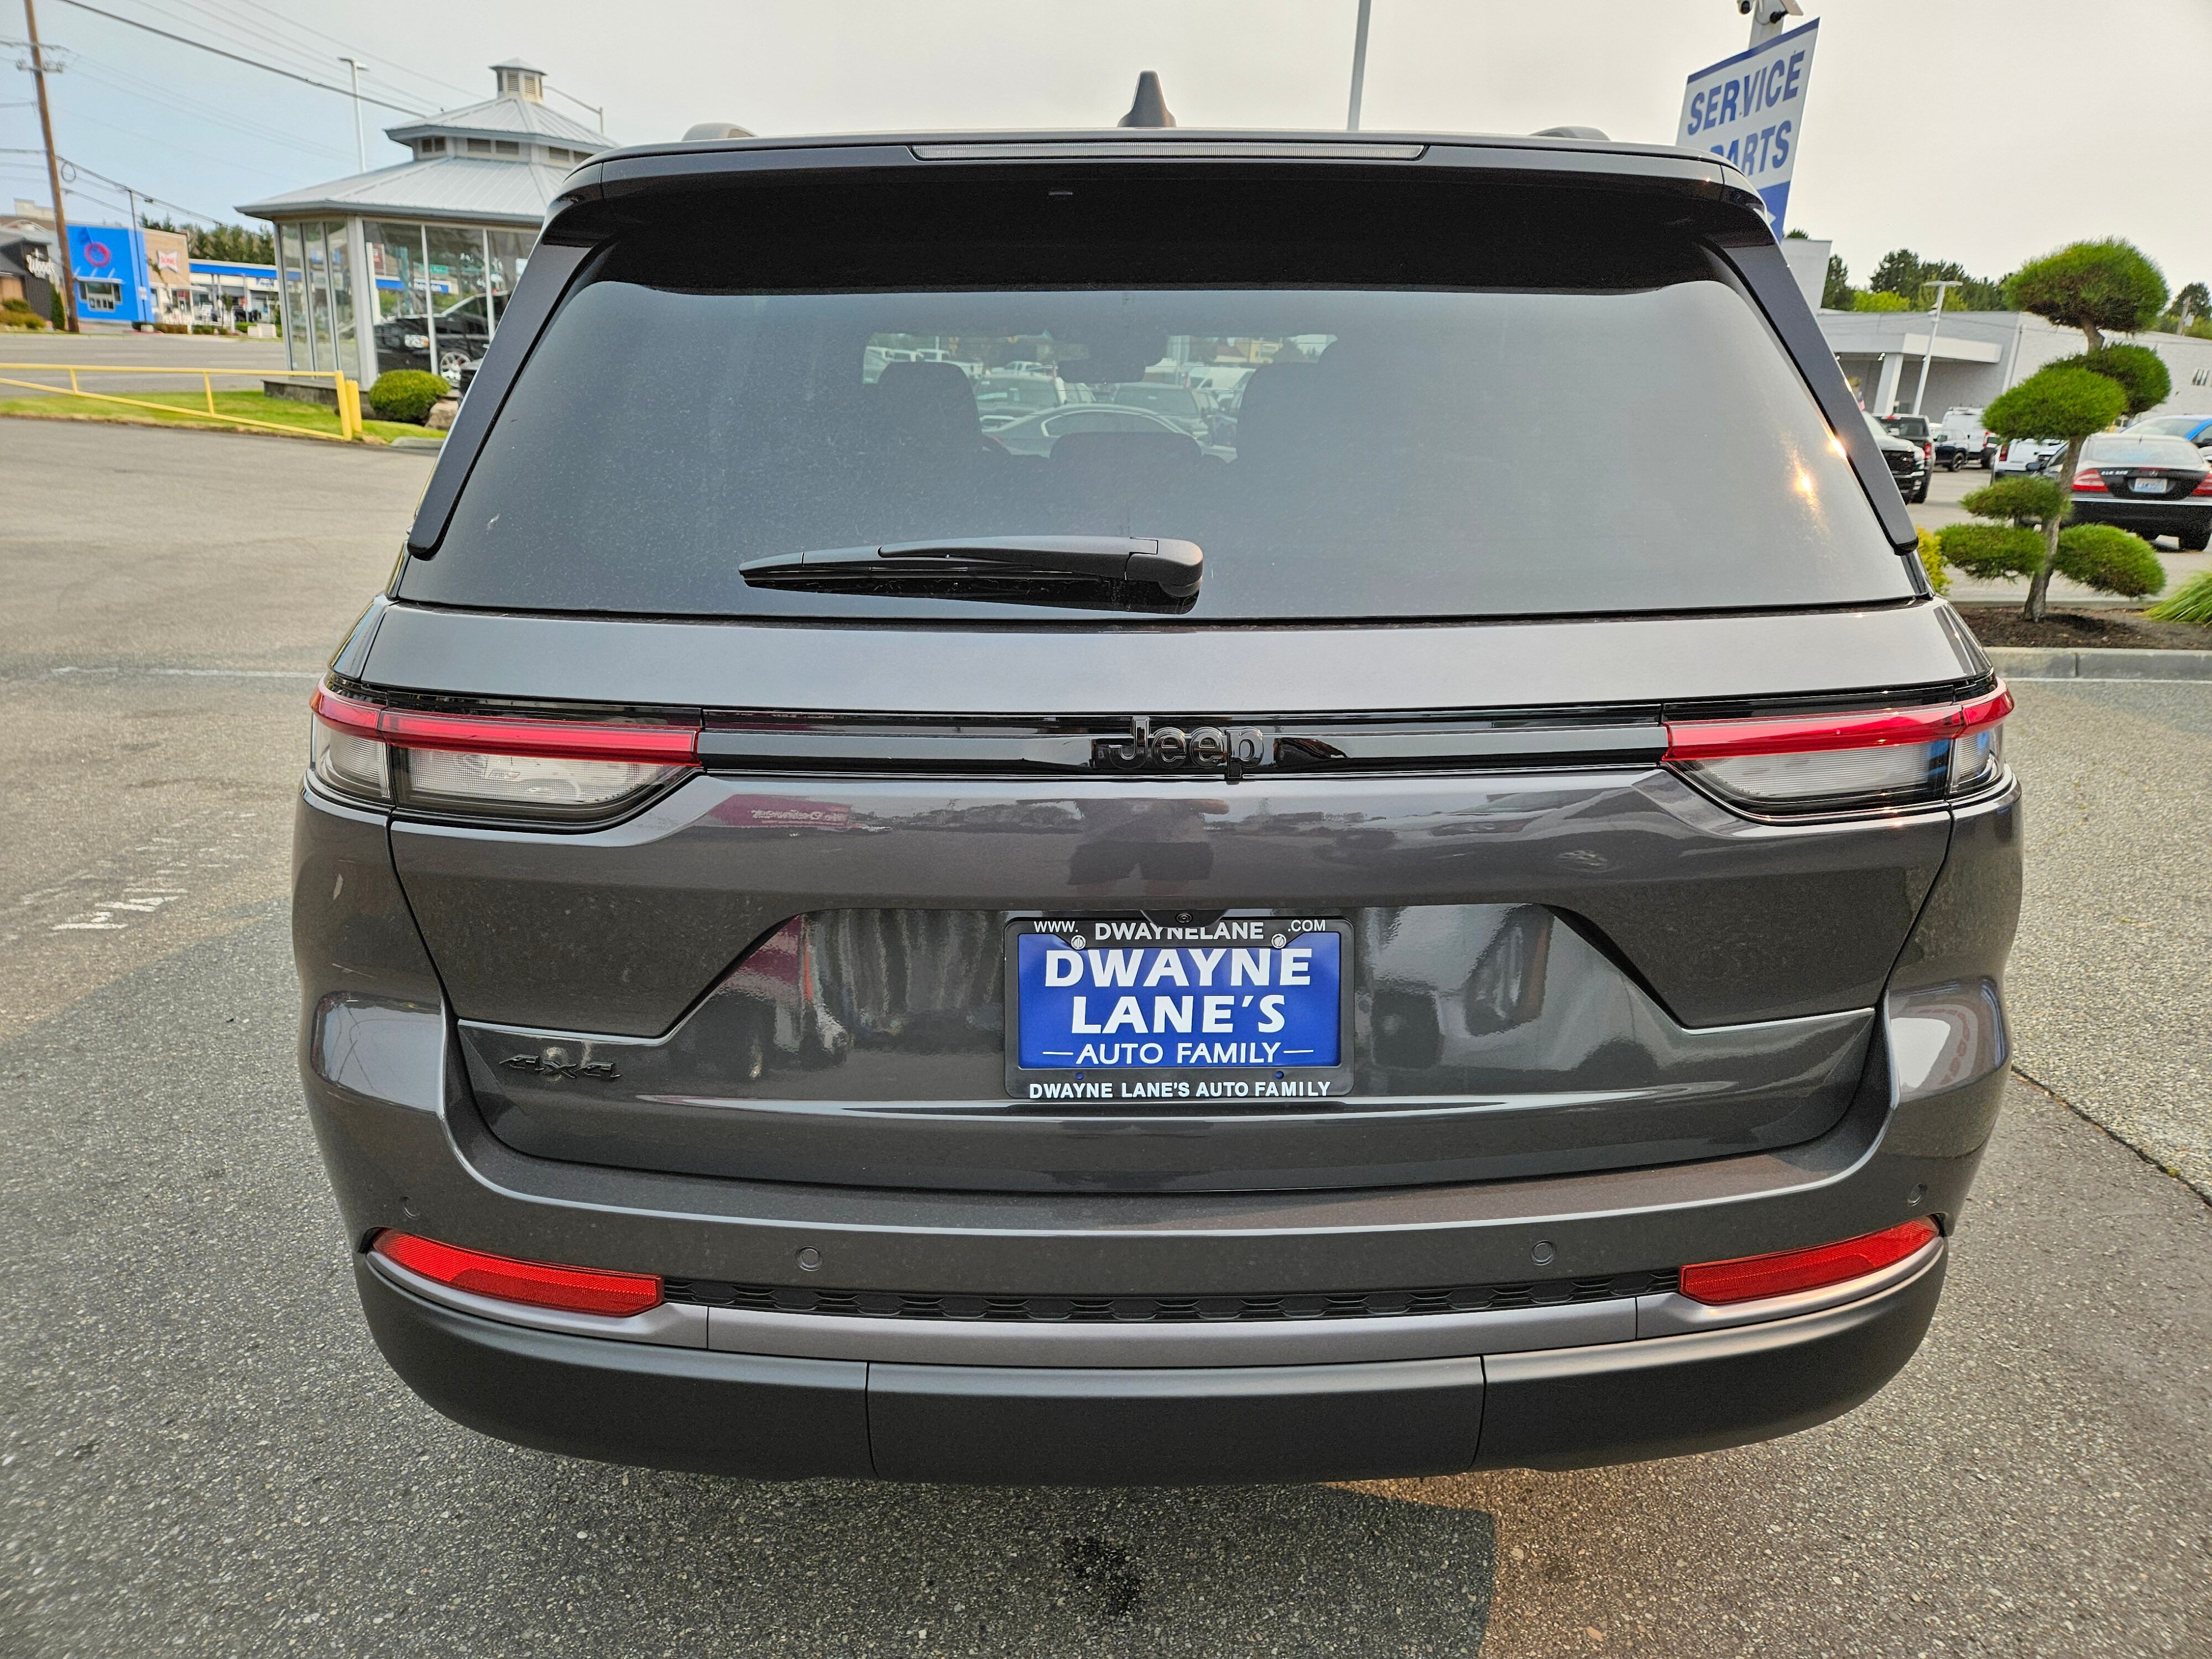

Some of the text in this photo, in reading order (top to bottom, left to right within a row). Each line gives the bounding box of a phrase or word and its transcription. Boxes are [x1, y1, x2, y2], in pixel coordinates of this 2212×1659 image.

[1687, 50, 1806, 135] SERVICE
[1109, 716, 1264, 785] Jeep
[1095, 922, 1264, 940] DWAYNELANE
[1287, 920, 1326, 932] .COM
[1045, 948, 1312, 987] DWAYNE
[1071, 994, 1285, 1034] LANE'S
[1076, 1042, 1281, 1065] AUTO FAMILY
[1029, 1081, 1331, 1099] DWAYNE LANE'S AUTO FAMILY
